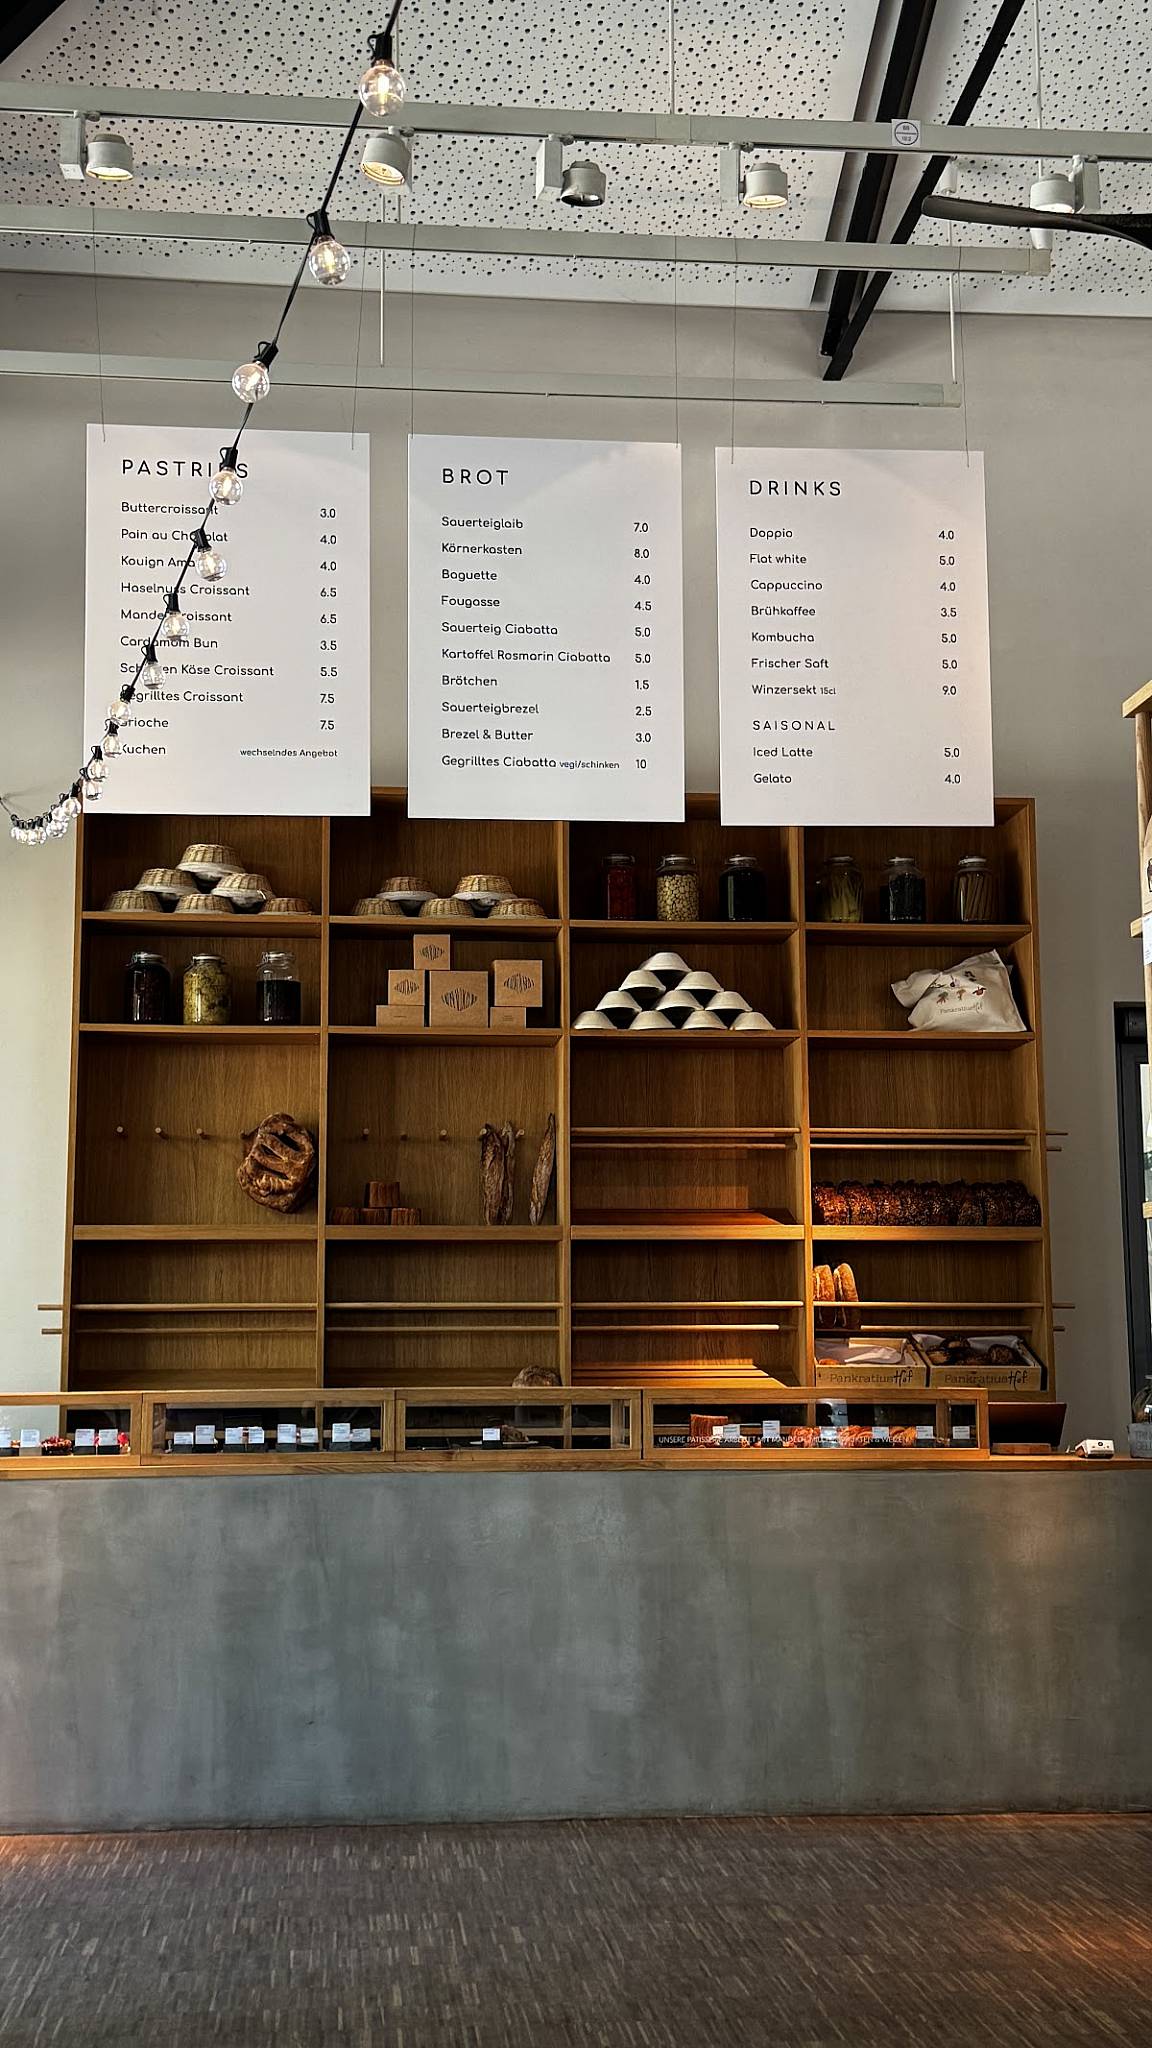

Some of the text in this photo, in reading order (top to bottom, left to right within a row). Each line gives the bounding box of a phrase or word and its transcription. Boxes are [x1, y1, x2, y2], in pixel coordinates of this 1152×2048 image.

[122, 459, 248, 478] PASTRIS
[442, 468, 508, 485] BROT
[750, 480, 841, 496] DRINKS
[320, 508, 336, 519] 3.0
[442, 516, 649, 533] Sauerteiglaib 7.0
[121, 529, 147, 539] Pain
[152, 531, 167, 540] au
[320, 534, 336, 545] 4.0
[750, 527, 954, 540] Doppio 4.0
[442, 543, 649, 559] Körnerkasten 8.0
[121, 556, 164, 568] Kouign
[320, 561, 336, 571] 4.0
[750, 554, 955, 566] Flat white 5.0
[442, 569, 650, 585] Baguette 4.0
[190, 584, 249, 596] Croissant
[320, 587, 337, 597] 6.5
[751, 580, 956, 592] Cappuccino 4.0
[442, 596, 651, 611] Fougasse 4.5
[751, 606, 957, 617] Brühkaffee 3.5
[320, 614, 337, 624] 6.5
[442, 622, 650, 637] Sauerteig Ciabatta 5.0
[194, 637, 218, 649] Bun
[320, 640, 337, 650] 3.5
[752, 632, 956, 643] Kombucha 5.0
[442, 649, 651, 663] Kartoffel Rosmarin Ciabatta 5.0
[182, 665, 210, 676] Käse
[214, 664, 274, 676] Croissant
[320, 667, 337, 677] 5.5
[752, 658, 957, 670] Frischer Saft 5.0
[442, 675, 649, 690] Brötchen 1.5
[752, 684, 957, 695] Winzersekt 15cl 9.0
[183, 691, 243, 702] Croissant
[320, 693, 334, 704] 7.5
[442, 702, 651, 716] Sauerteigbrezel 2.5
[320, 720, 334, 730] 7.5
[753, 720, 835, 731] SAISONAL
[442, 729, 651, 743] Brezel & Butter 3.0
[240, 748, 297, 757] wechselndes
[299, 748, 337, 759] Angebot
[753, 747, 960, 758] Iced Latte 5.0
[442, 755, 646, 770] Gegrilltes Ciabatta vegi/schinken 10
[753, 773, 960, 784] Gelato 4.0
